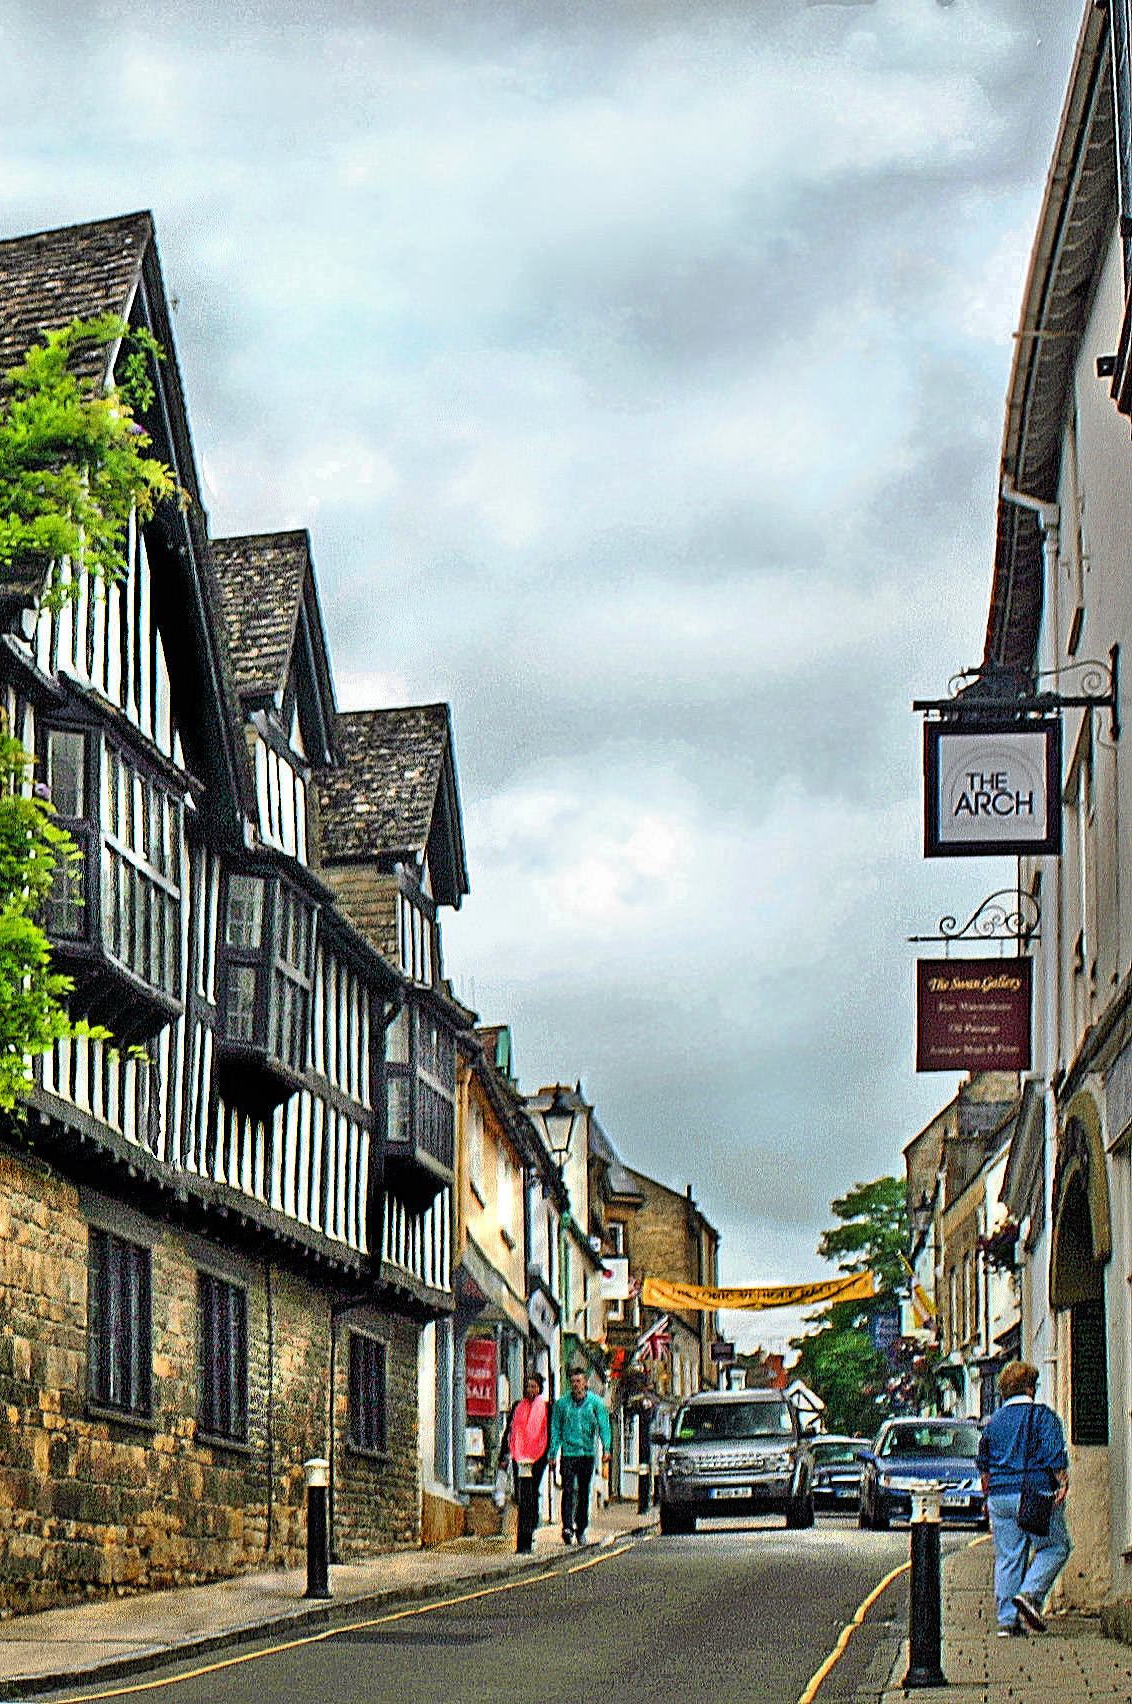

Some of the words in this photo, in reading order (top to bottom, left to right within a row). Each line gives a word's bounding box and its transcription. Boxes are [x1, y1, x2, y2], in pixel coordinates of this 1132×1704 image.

[965, 772, 1007, 791] THE
[953, 790, 1033, 817] ARCH
[929, 977, 949, 992] The
